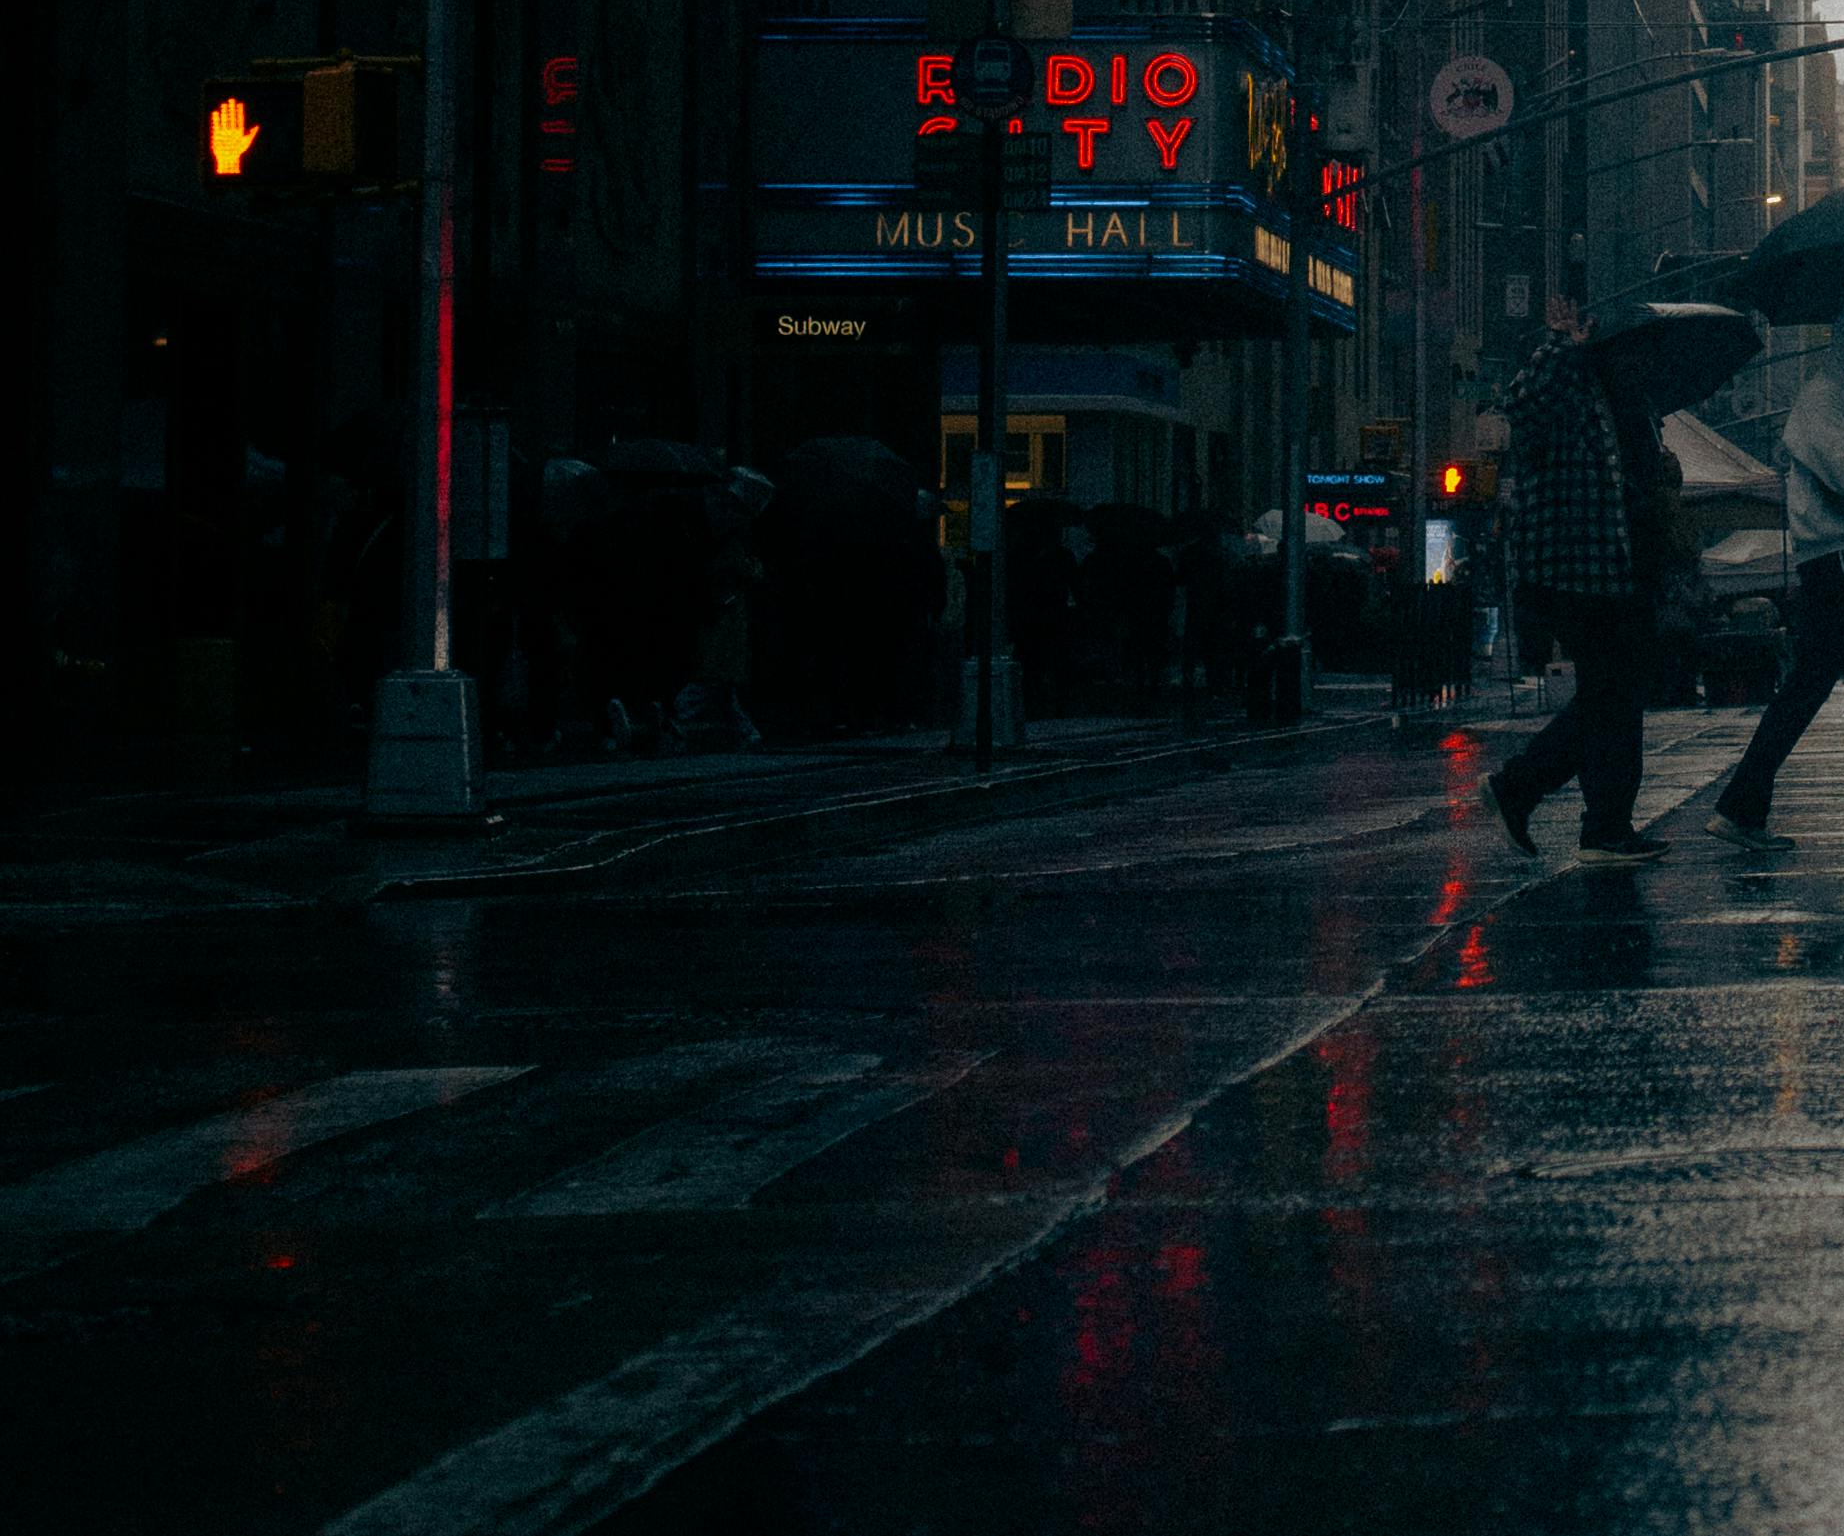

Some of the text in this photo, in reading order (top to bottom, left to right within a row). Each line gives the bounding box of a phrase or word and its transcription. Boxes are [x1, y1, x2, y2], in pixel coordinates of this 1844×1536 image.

[916, 54, 1198, 106] RDIO
[777, 315, 866, 341] Subway
[1307, 474, 1385, 485] TONIGHT SHOW
[1304, 502, 1350, 522] BC
